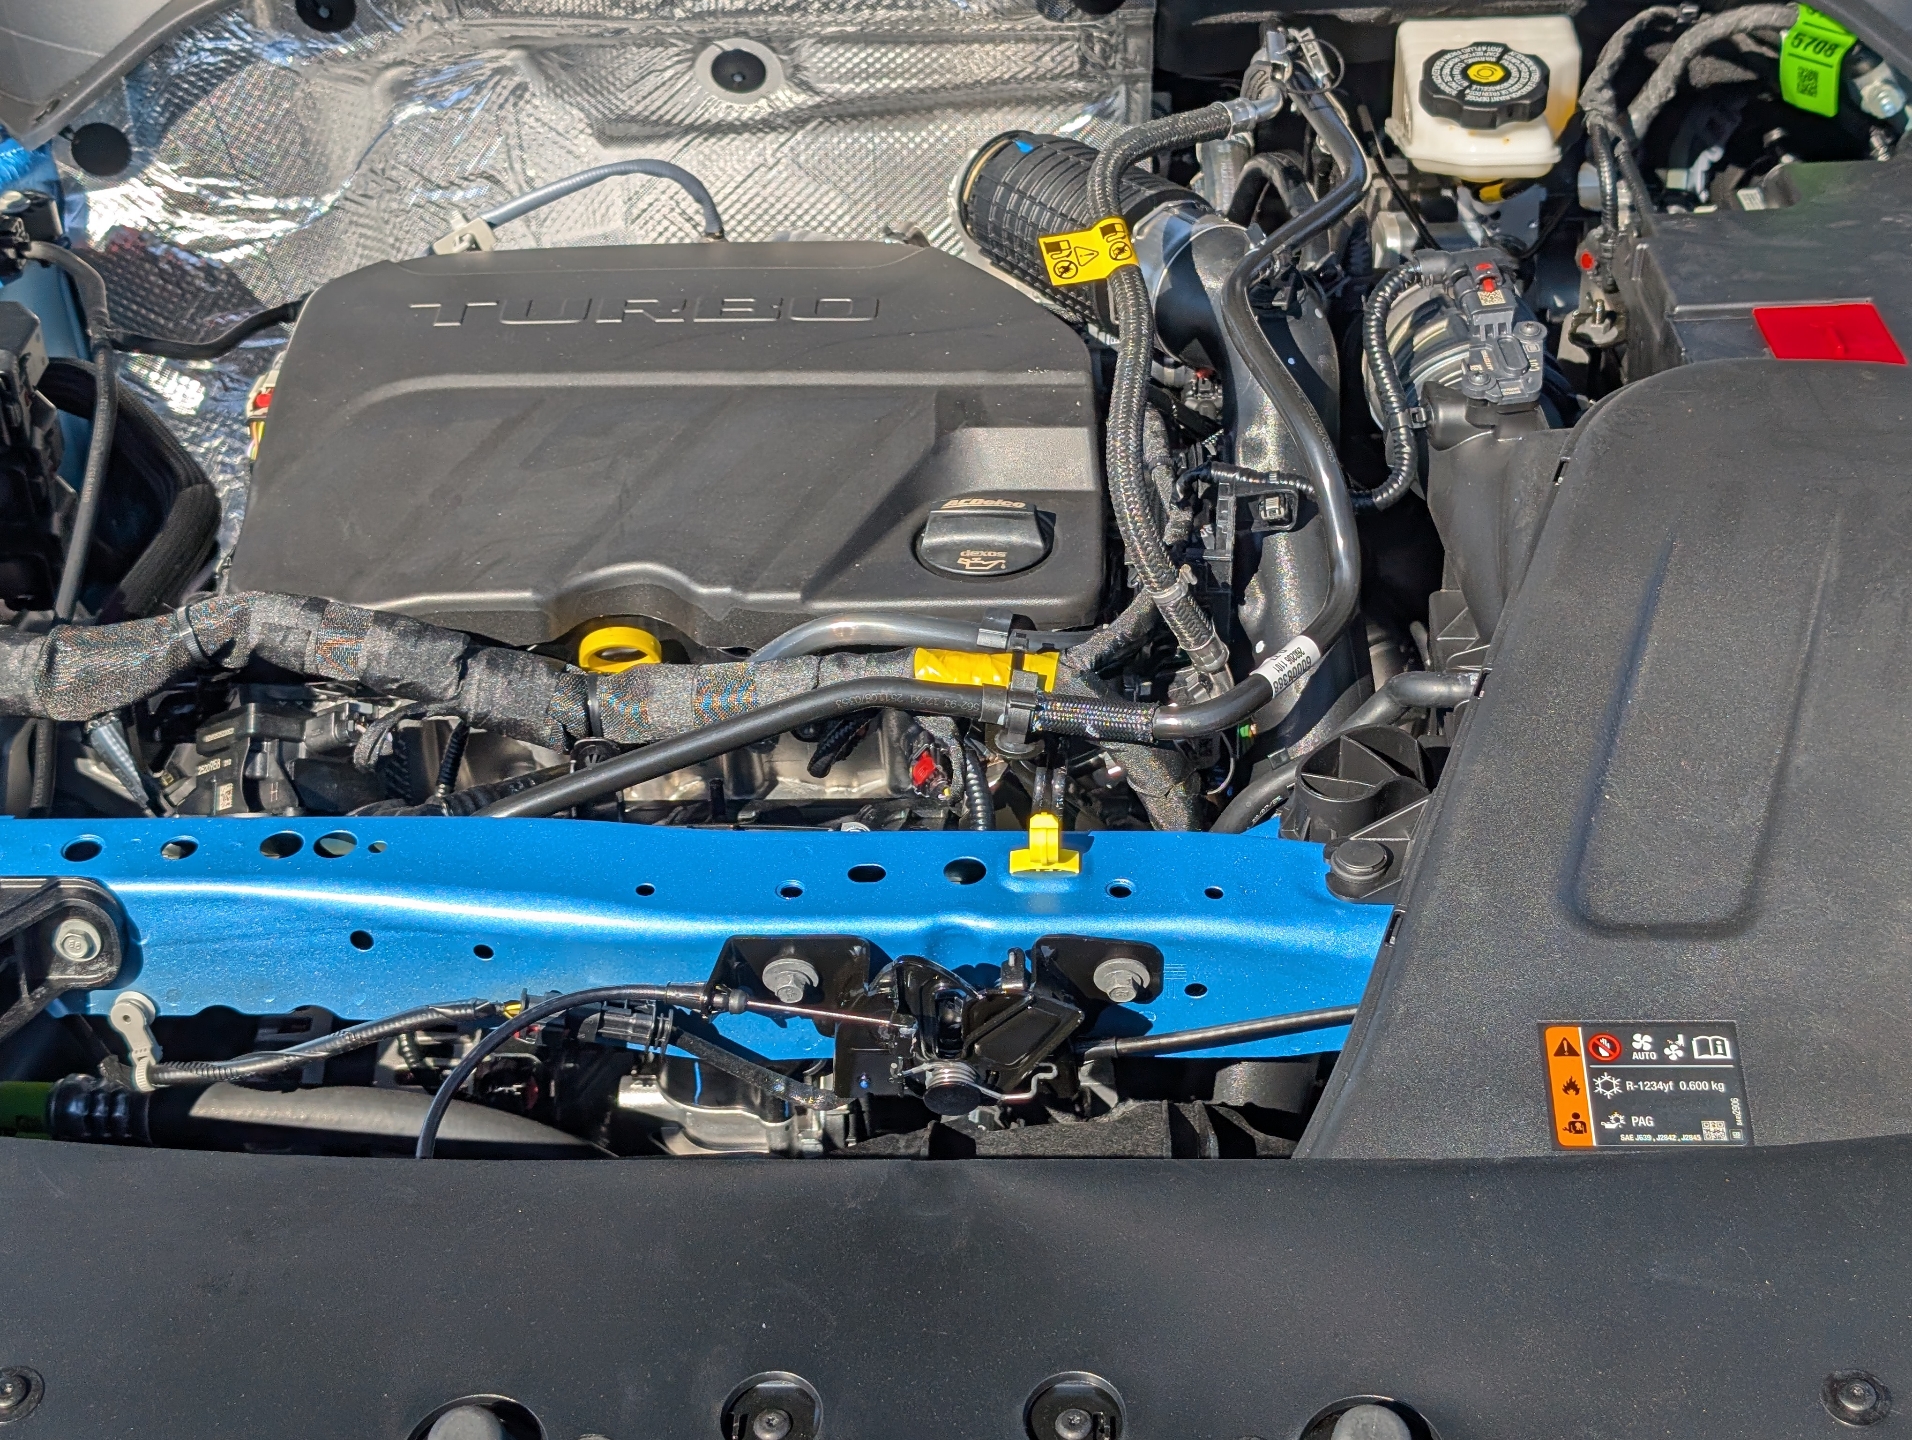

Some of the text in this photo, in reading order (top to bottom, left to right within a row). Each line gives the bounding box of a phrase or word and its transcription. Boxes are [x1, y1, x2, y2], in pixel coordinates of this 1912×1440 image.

[408, 297, 880, 328] TURBO
[940, 498, 1026, 510] ACDelco
[959, 549, 1008, 558] dexos
[1632, 1051, 1657, 1061] AUTO
[1625, 1080, 1725, 1093] R-1234yf 0.600 kg
[1630, 1115, 1655, 1128] PAG
[1620, 1133, 1634, 1142] SAE
